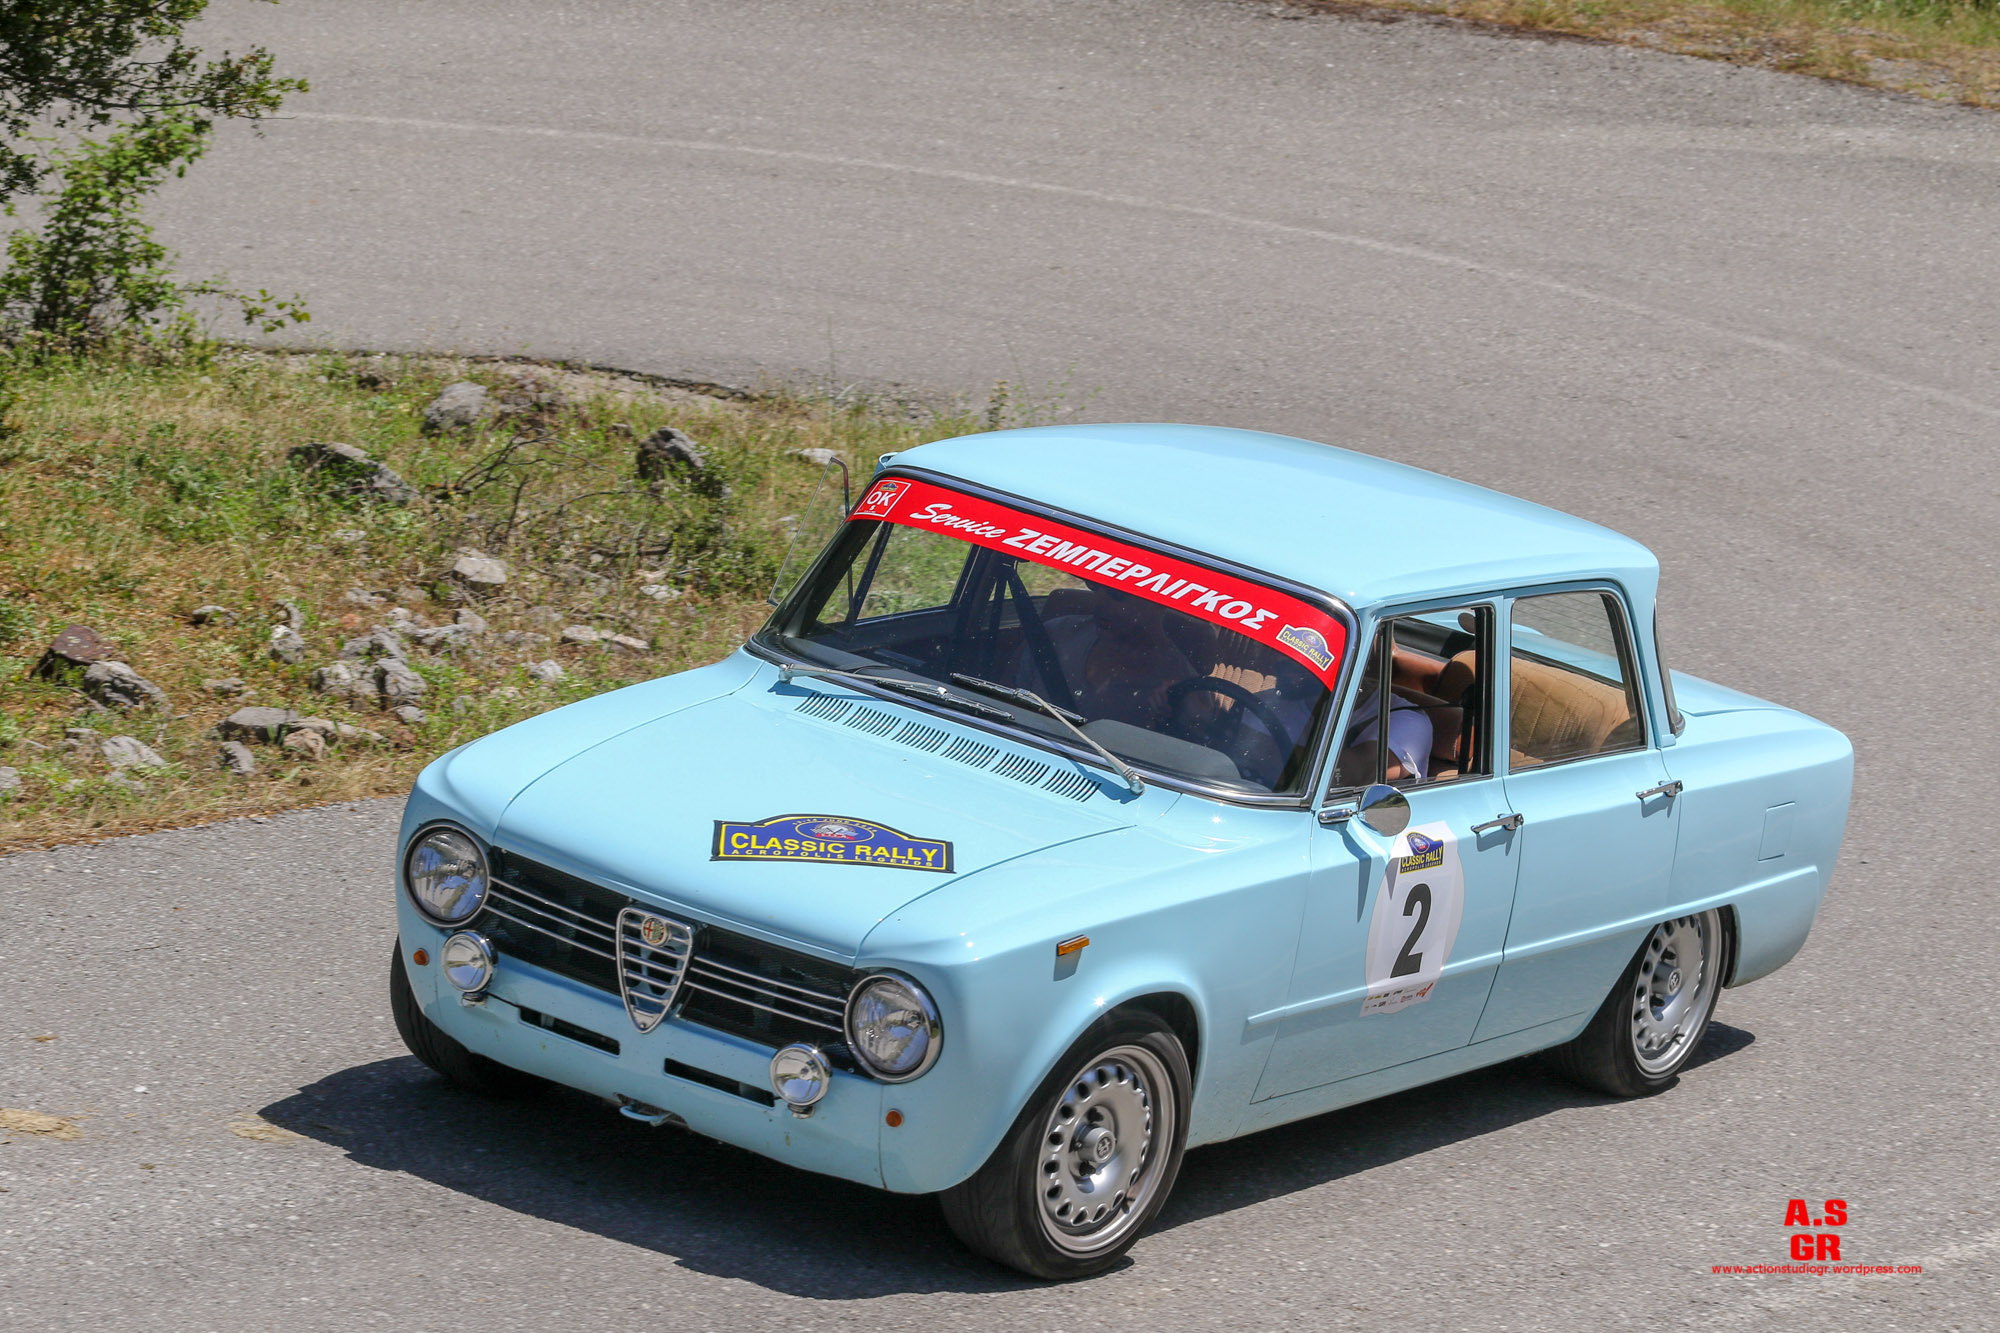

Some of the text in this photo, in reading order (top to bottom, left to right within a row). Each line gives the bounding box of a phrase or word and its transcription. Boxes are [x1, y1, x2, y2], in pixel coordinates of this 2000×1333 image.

[866, 491, 897, 507] OK
[909, 503, 1007, 539] Service
[1001, 527, 1279, 630] ΖΕΜΠΕΡΛΙΓΚΟΣ
[1282, 630, 1310, 651] CLASSIC
[1309, 648, 1330, 665] RALLY
[731, 832, 938, 862] CLASSIC RALLY
[731, 849, 933, 867] ACROPOLIS LEGENDS
[1401, 846, 1443, 868] CLASSIC RALLY
[1390, 883, 1432, 979] 2
